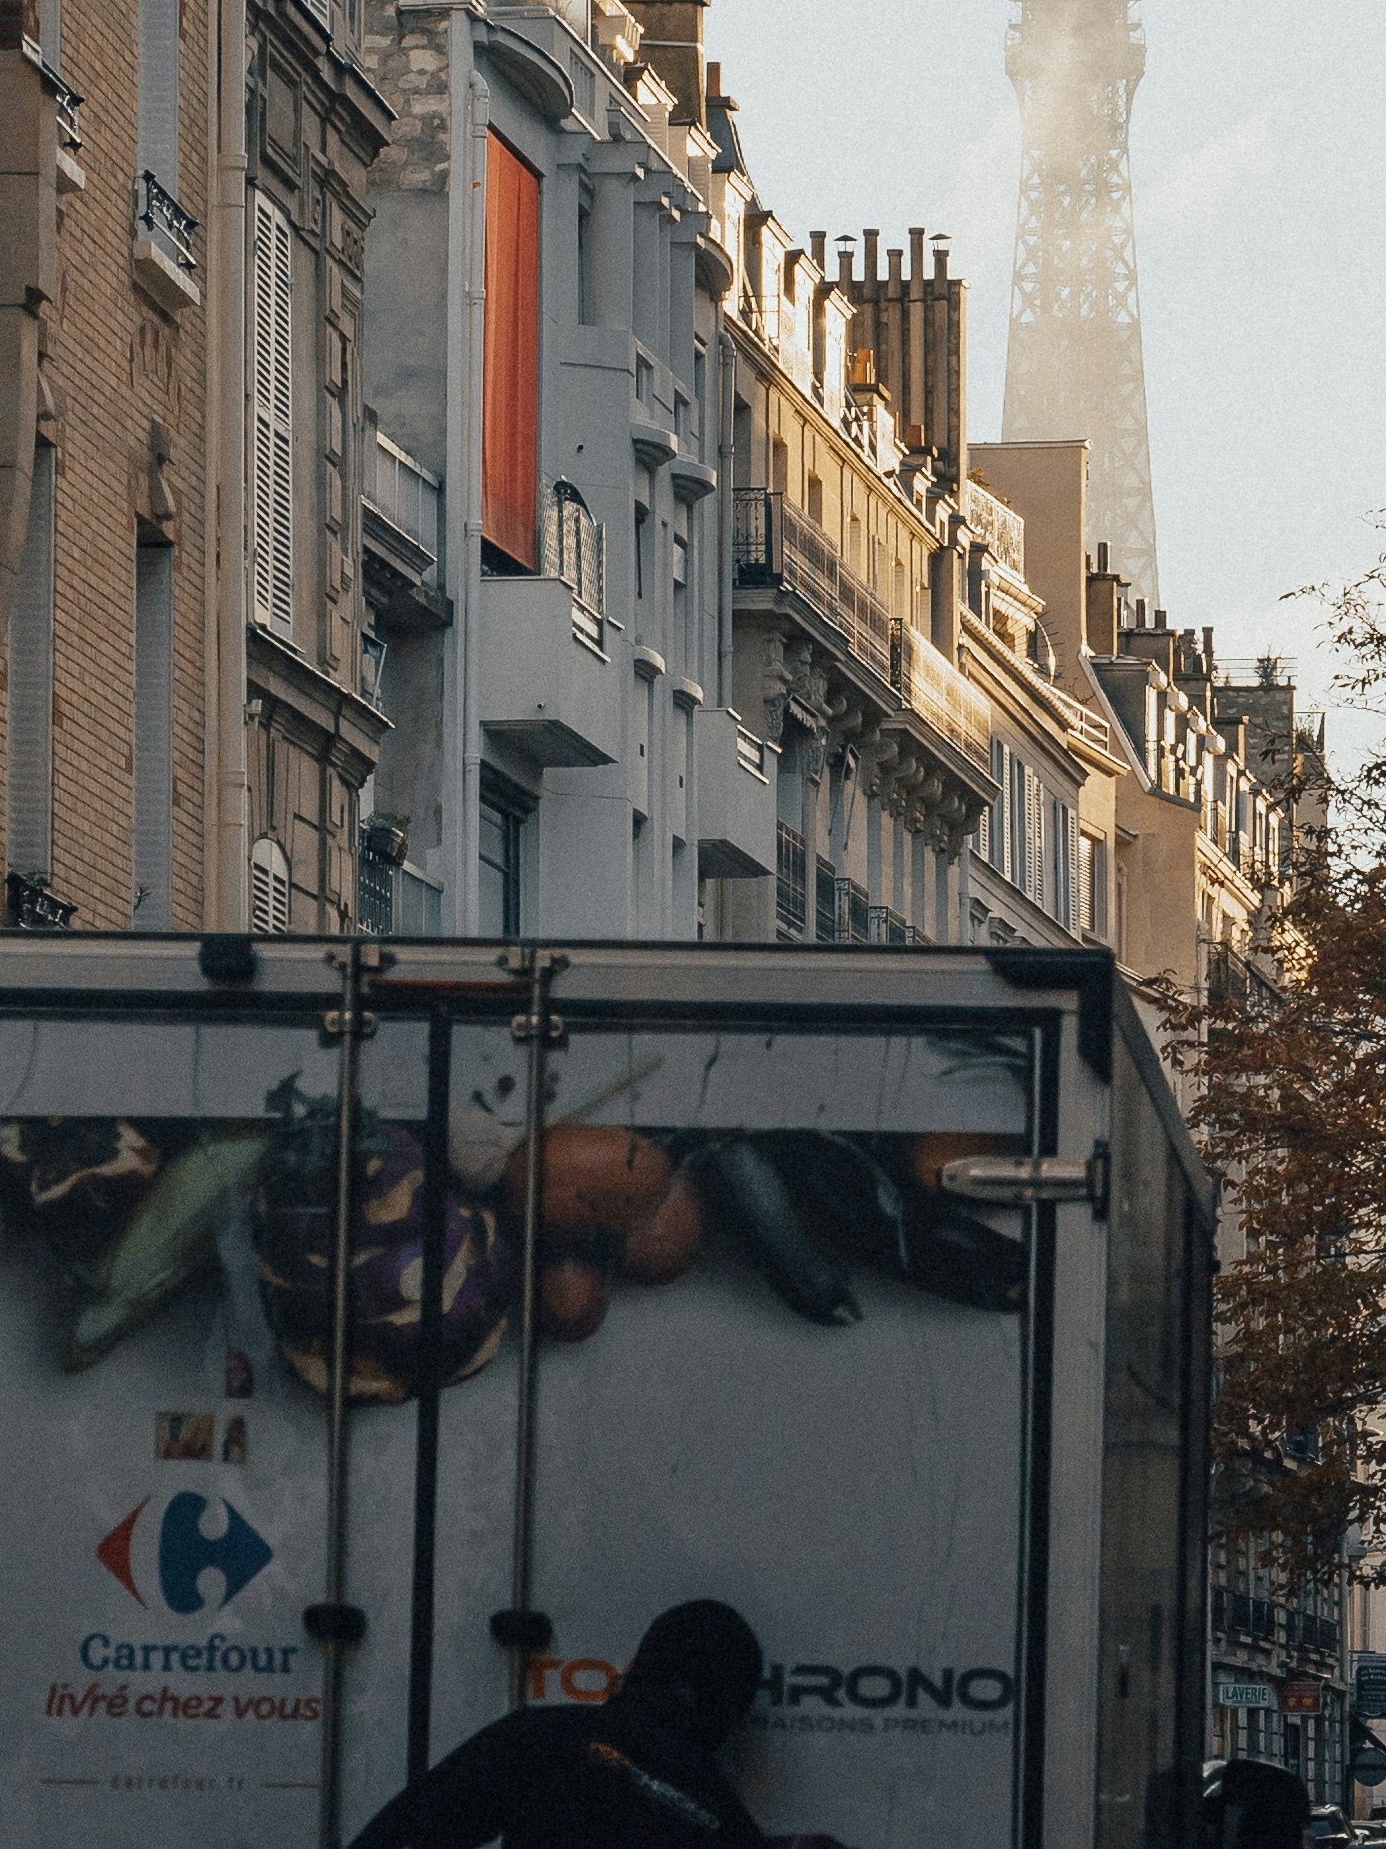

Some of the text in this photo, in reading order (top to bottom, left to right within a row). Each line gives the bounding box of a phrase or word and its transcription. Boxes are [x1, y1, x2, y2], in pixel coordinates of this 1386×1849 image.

[79, 1631, 300, 1674] Carrefour
[44, 1681, 324, 1722] livré chez vous
[530, 1657, 1017, 1712] TO HRONO
[1225, 1686, 1268, 1702] LAVERIE
[882, 1717, 1011, 1736] PREMIUM
